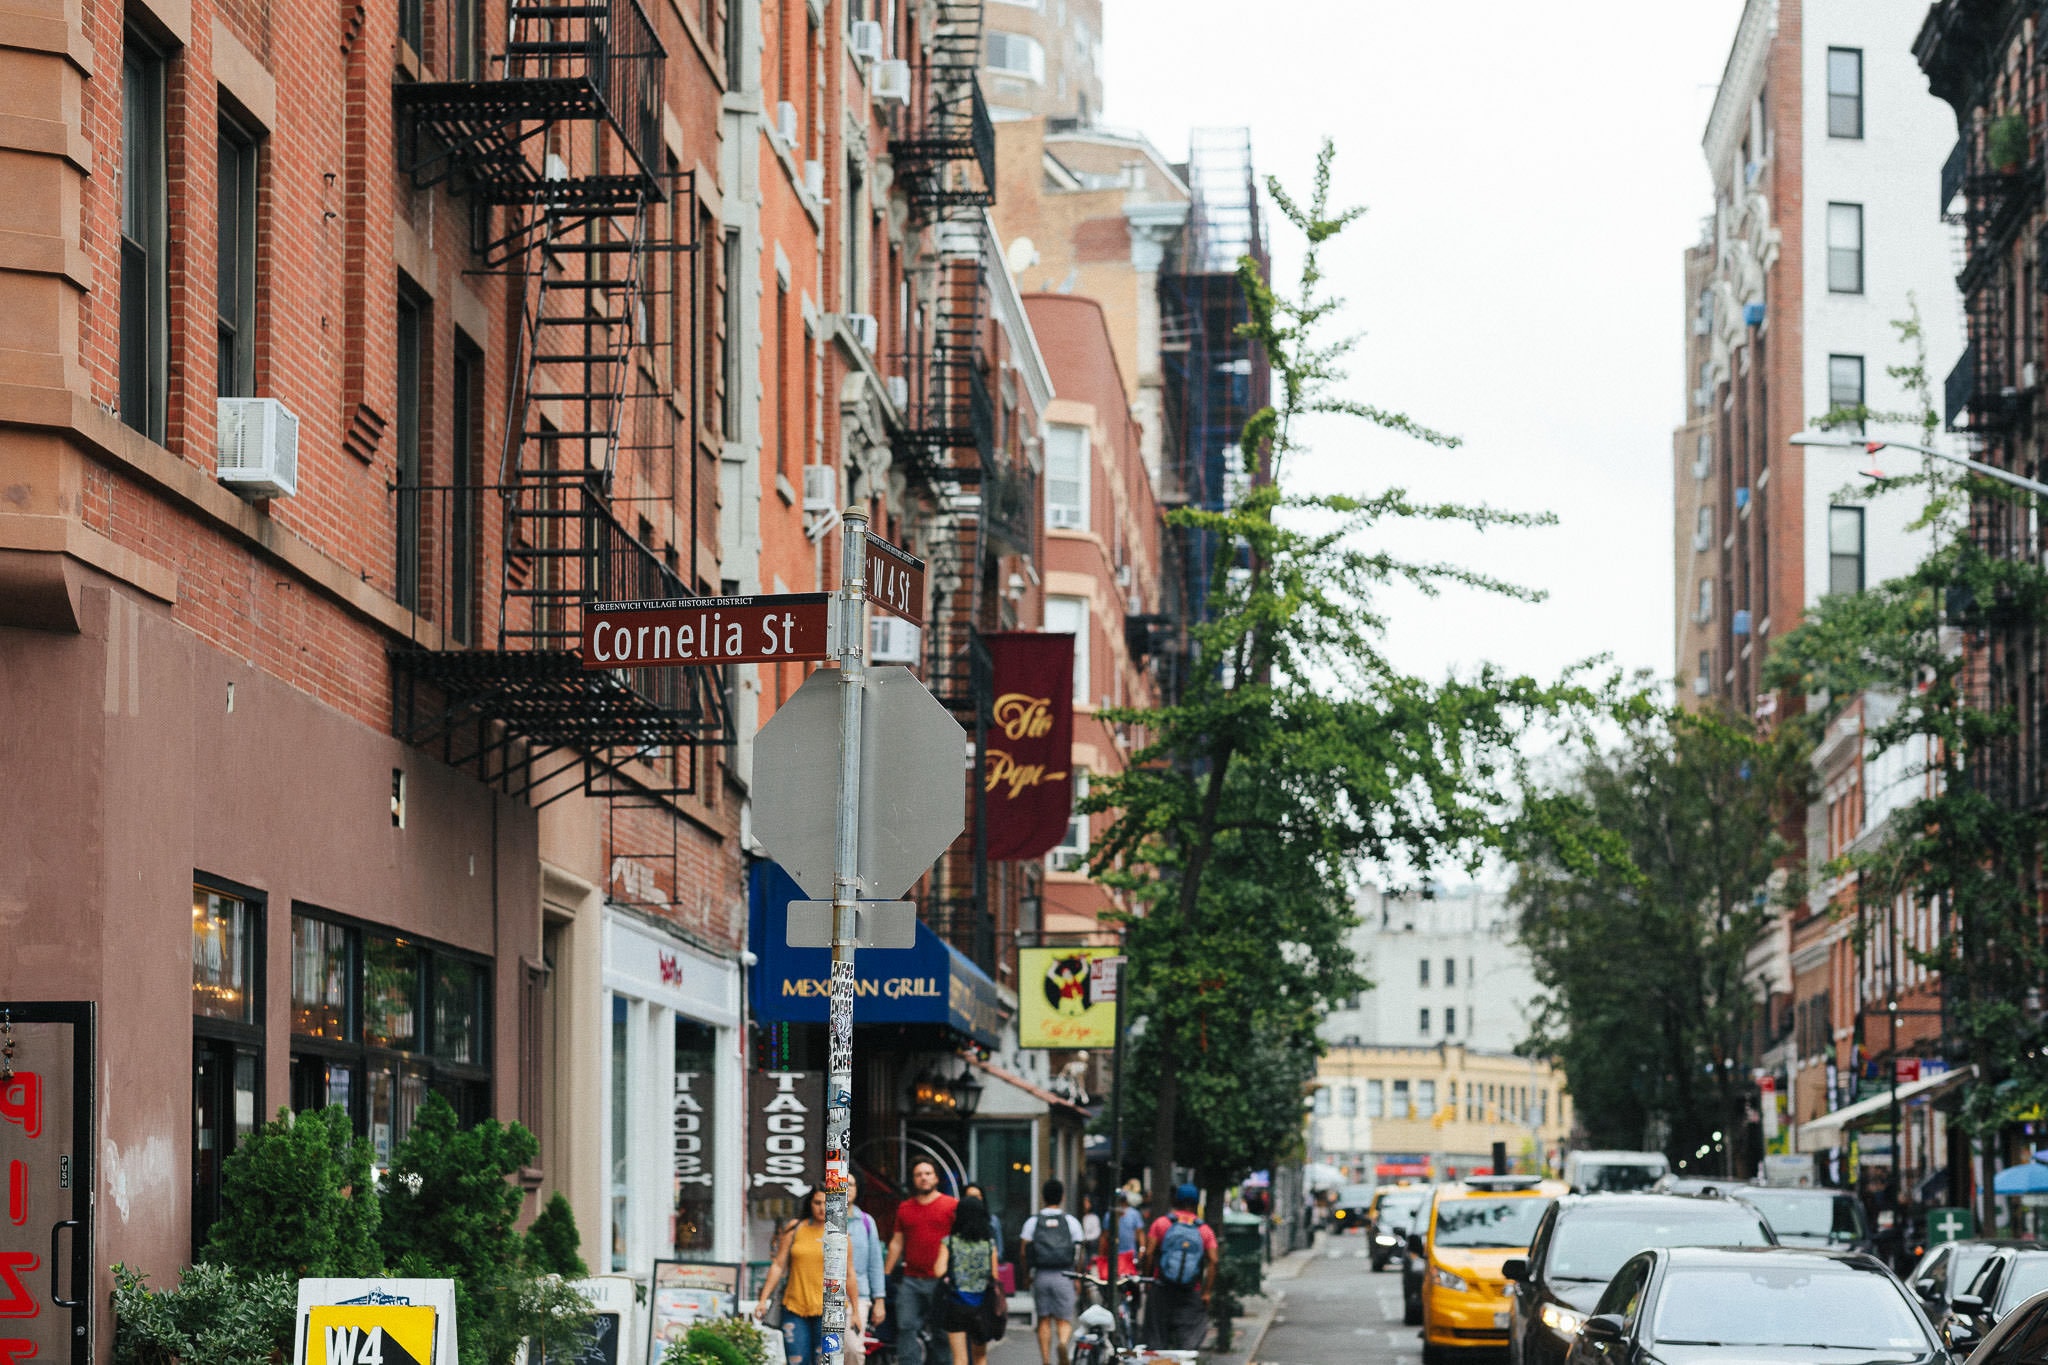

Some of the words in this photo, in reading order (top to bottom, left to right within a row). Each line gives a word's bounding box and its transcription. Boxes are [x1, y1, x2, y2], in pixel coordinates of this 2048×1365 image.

[594, 602, 641, 611] GREENWICH
[643, 600, 677, 609] VILLAGE
[678, 599, 715, 608] HISTORIC
[717, 598, 753, 606] DISTRICT
[874, 556, 884, 598] W
[888, 566, 895, 604] 4
[898, 570, 910, 613] St
[593, 612, 743, 661] Cornelia
[761, 612, 795, 656] St
[782, 978, 878, 997] MEXIAN
[884, 978, 941, 999] GRILL
[762, 1072, 808, 1175] TACOS
[325, 1325, 384, 1365] W4
